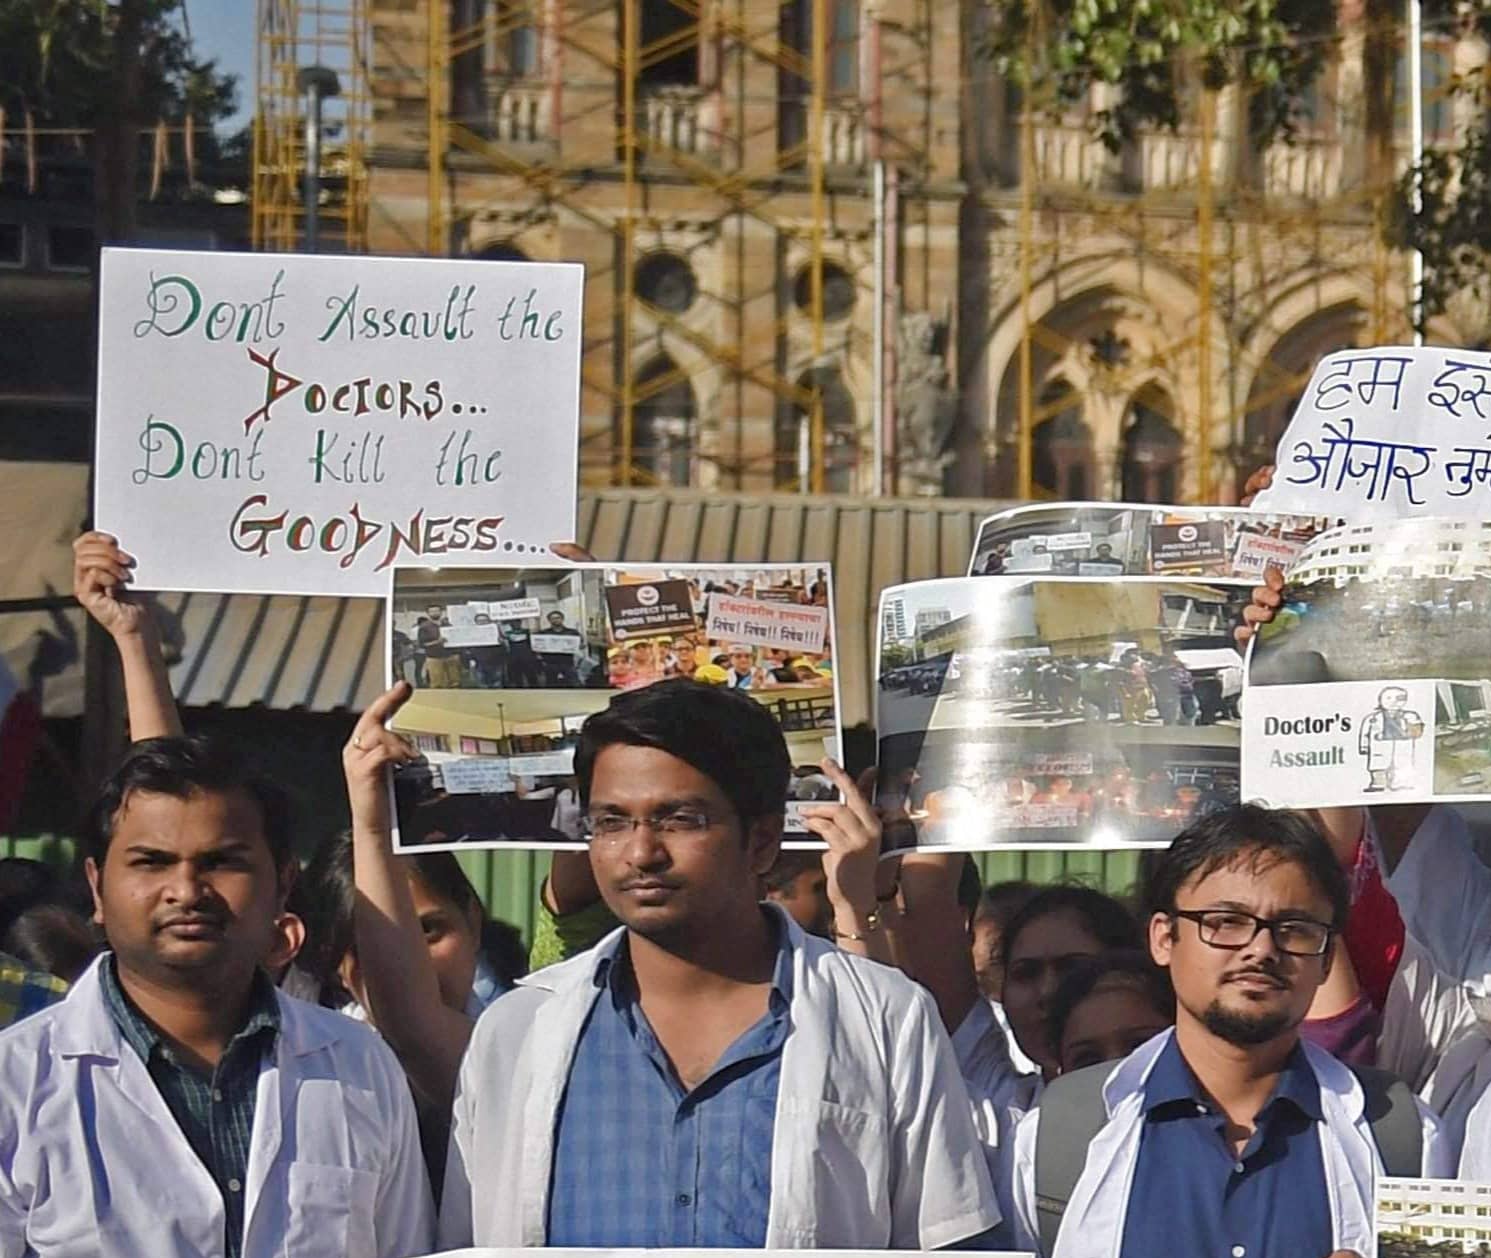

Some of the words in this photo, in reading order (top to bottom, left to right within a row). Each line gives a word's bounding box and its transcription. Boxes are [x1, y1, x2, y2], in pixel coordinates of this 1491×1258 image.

[133, 268, 285, 344] Dont
[317, 284, 477, 342] Assault
[498, 287, 565, 342] the
[1314, 356, 1414, 411] हम
[132, 413, 265, 485] Dont
[308, 429, 386, 485] Kill
[435, 430, 503, 488] the
[621, 604, 660, 617] PROTECT
[662, 602, 678, 613] THE
[667, 610, 691, 622] HEAL
[1264, 713, 1352, 737] Doctor's
[1269, 746, 1345, 768] Assault
